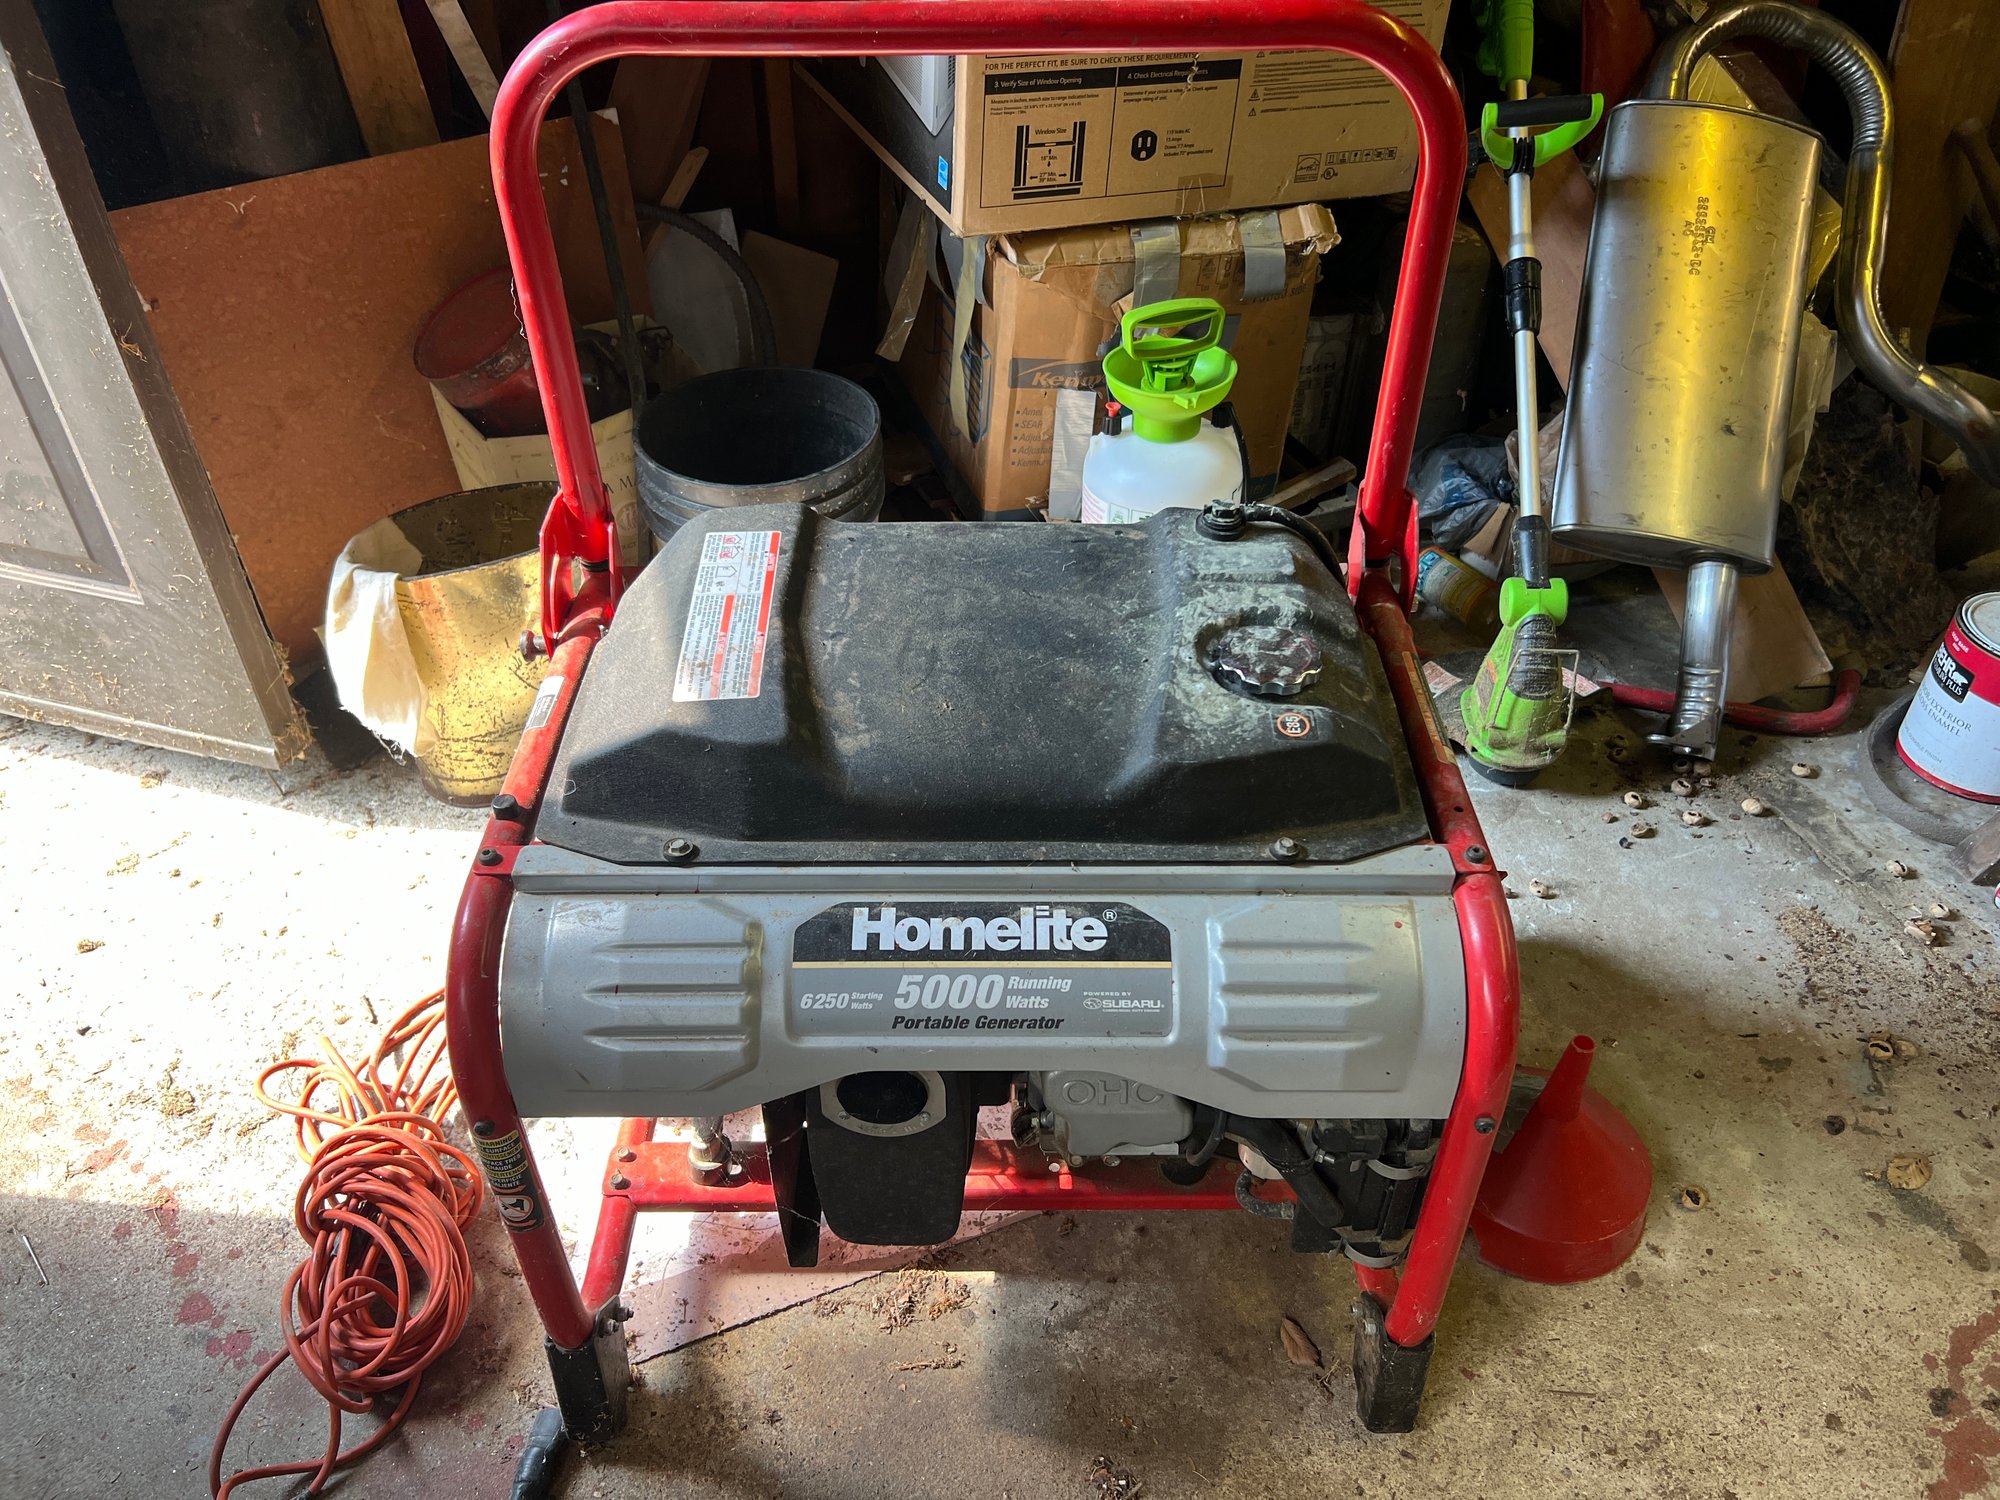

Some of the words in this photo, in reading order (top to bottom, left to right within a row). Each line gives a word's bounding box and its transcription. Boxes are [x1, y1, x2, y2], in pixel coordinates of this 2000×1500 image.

[985, 63, 999, 71] FOR
[1000, 62, 1014, 70] THE
[1016, 61, 1045, 69] PERFECT
[1047, 60, 1059, 68] FIT,
[1060, 59, 1069, 67] BE
[1071, 58, 1088, 66] SURE
[1090, 57, 1098, 65] TO
[1100, 56, 1122, 64] CHECK
[1124, 54, 1144, 62] THESE
[1000, 80, 1017, 89] Verify
[1037, 77, 1059, 86] Window
[1060, 76, 1082, 85] Opening
[1133, 72, 1150, 80] Check
[1150, 70, 1173, 79] Electrical
[1034, 128, 1056, 136] Window
[1056, 126, 1067, 135] Size
[1945, 678, 1963, 696] PLUS
[1928, 708, 1961, 736] ENAMEL
[852, 905, 1108, 951] Homelite
[893, 973, 1005, 1010] 5000
[1008, 975, 1072, 992] Running
[800, 992, 850, 1009] 6250
[851, 991, 883, 1001] Starting
[851, 1001, 873, 1010] Watts
[1006, 995, 1050, 1009] Watts
[1102, 999, 1161, 1009] SUBARU
[892, 1015, 970, 1030] Portable
[975, 1015, 1065, 1030] Generator
[1063, 1079, 1164, 1105] OHC
